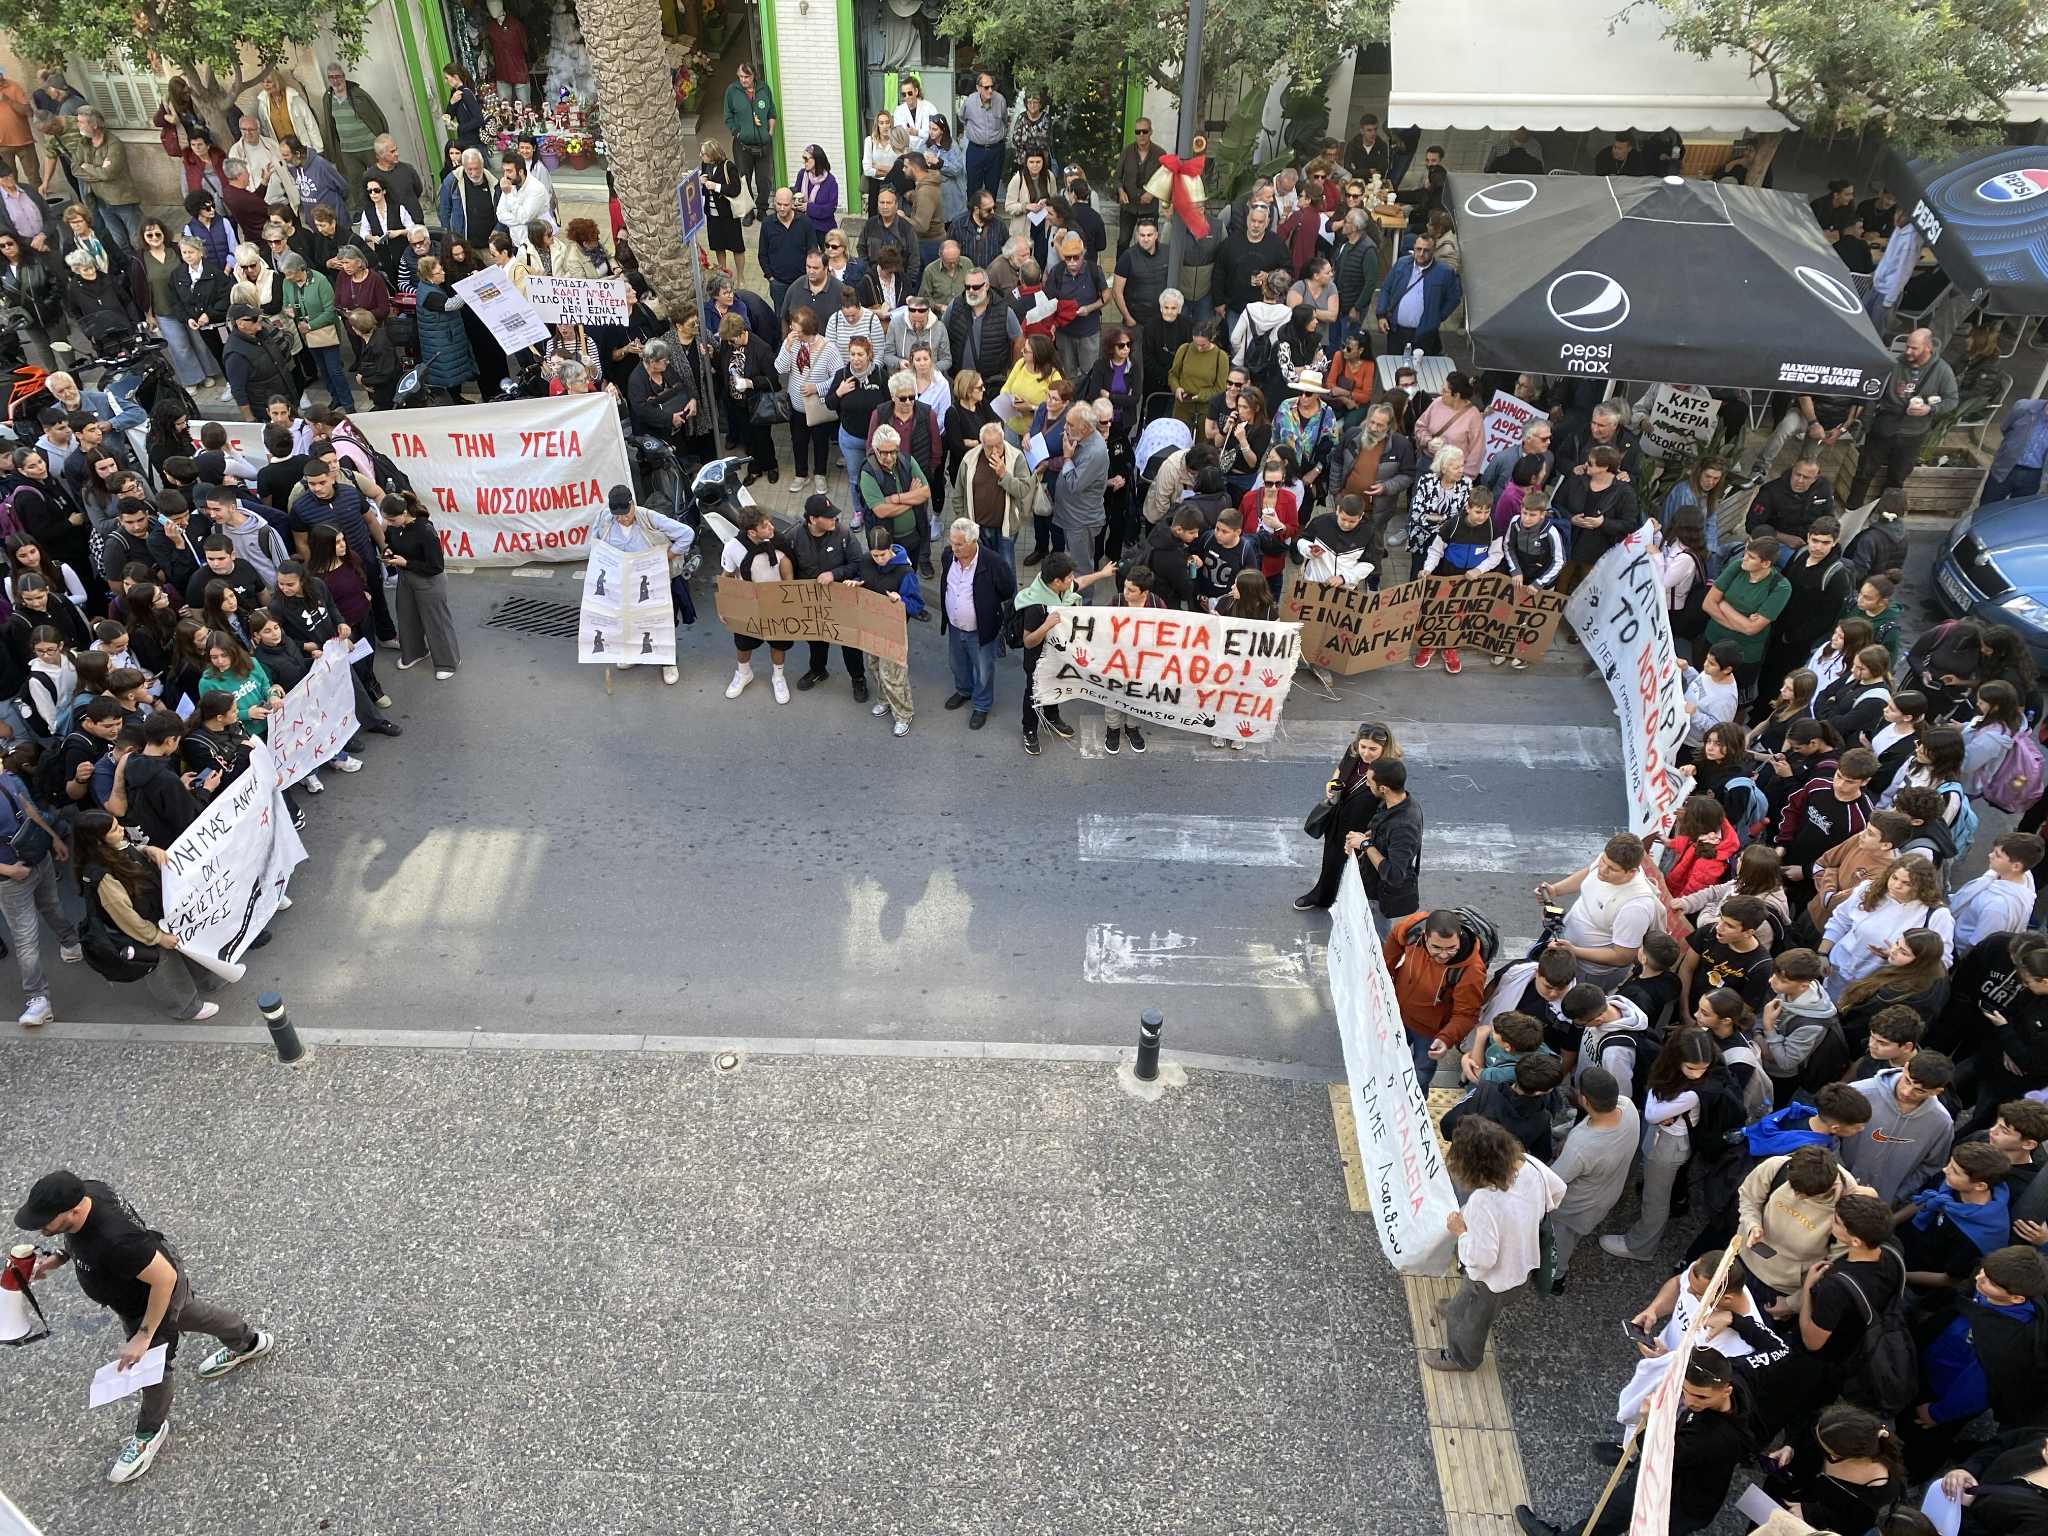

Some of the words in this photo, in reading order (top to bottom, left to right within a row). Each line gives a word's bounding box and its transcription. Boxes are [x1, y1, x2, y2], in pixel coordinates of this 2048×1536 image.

[2001, 173, 2034, 198] PEPSI
[1912, 199, 1943, 245] PEPSI
[530, 277, 543, 285] ΤΑ
[551, 278, 589, 288] ΠΑΙΔΙΑ
[596, 281, 615, 290] ΤΟΥ
[552, 287, 580, 297] ΚΔΑΠ
[562, 305, 582, 314] ΔΕΝ
[588, 306, 617, 315] ΕΙΝΑΙ
[599, 299, 626, 307] ΥΓΕΙΑ
[1560, 343, 1612, 360] pepsi
[1568, 359, 1610, 373] max
[1778, 371, 1819, 384] ZERO
[1820, 375, 1860, 387] SUGAR
[1780, 363, 1831, 375] MAXIMUM
[1831, 367, 1863, 378] TASTE
[1656, 401, 1669, 416] ΤΑ
[1670, 410, 1710, 428] ΧΕΡΙΑ
[391, 433, 427, 458] ΓΙΑ
[448, 432, 496, 458] ΤΗΝ
[520, 430, 582, 457] ΥΓΕΙΑ
[432, 488, 460, 513] ΤΑ
[476, 479, 605, 515] ΝΟΣΟΚΟΜΕΙΑ
[493, 525, 589, 553] ΛΑΣΙΘΙΟΥ
[779, 583, 832, 603] ΣΤΗΝ
[1294, 580, 1307, 600] Η
[1318, 585, 1380, 614] ΥΓΕΙΑ
[1388, 579, 1424, 608] ΔΕΝ
[1424, 580, 1441, 600] Η
[1449, 577, 1514, 607] ΥΓΕΙΑ
[1519, 594, 1568, 613] ΔΕΝ
[803, 606, 834, 621] ΤΗΣ
[1299, 606, 1362, 635] ΕΙΝΑΙ
[1420, 598, 1494, 616] ΚΛΕΙΝΕΙ
[1514, 609, 1547, 629] ΤΟ
[1610, 596, 1639, 643] ΤΟ
[746, 616, 843, 642] ΔΗΜΟΣΙΑΣ
[1069, 616, 1096, 643] Η
[1111, 615, 1210, 649] ΥΓΕΙΑ
[1223, 629, 1295, 658] ΕΙΝΑΙ
[1324, 623, 1415, 656] ΑΝΑΓΚΗ
[1418, 631, 1447, 647] ΘΑ
[1453, 631, 1515, 655] ΜΕΙΝΕΙ
[1102, 649, 1251, 686] ΑΓΑΘΟ!
[1056, 663, 1182, 705] ΔΩΡΕΑΝ
[1196, 689, 1274, 721] ΥΓΕΙΑ
[197, 812, 233, 850] ΜΑΣ
[233, 776, 259, 818] ΑΝΗ
[202, 855, 221, 882] ΟΧΙ
[1363, 1076, 1387, 1143] ΕΛΜΕ
[1402, 1067, 1439, 1180] ΔΩΡΕΑΝ
[1393, 1103, 1424, 1218] ΠΑΙΔΕΙΑ
